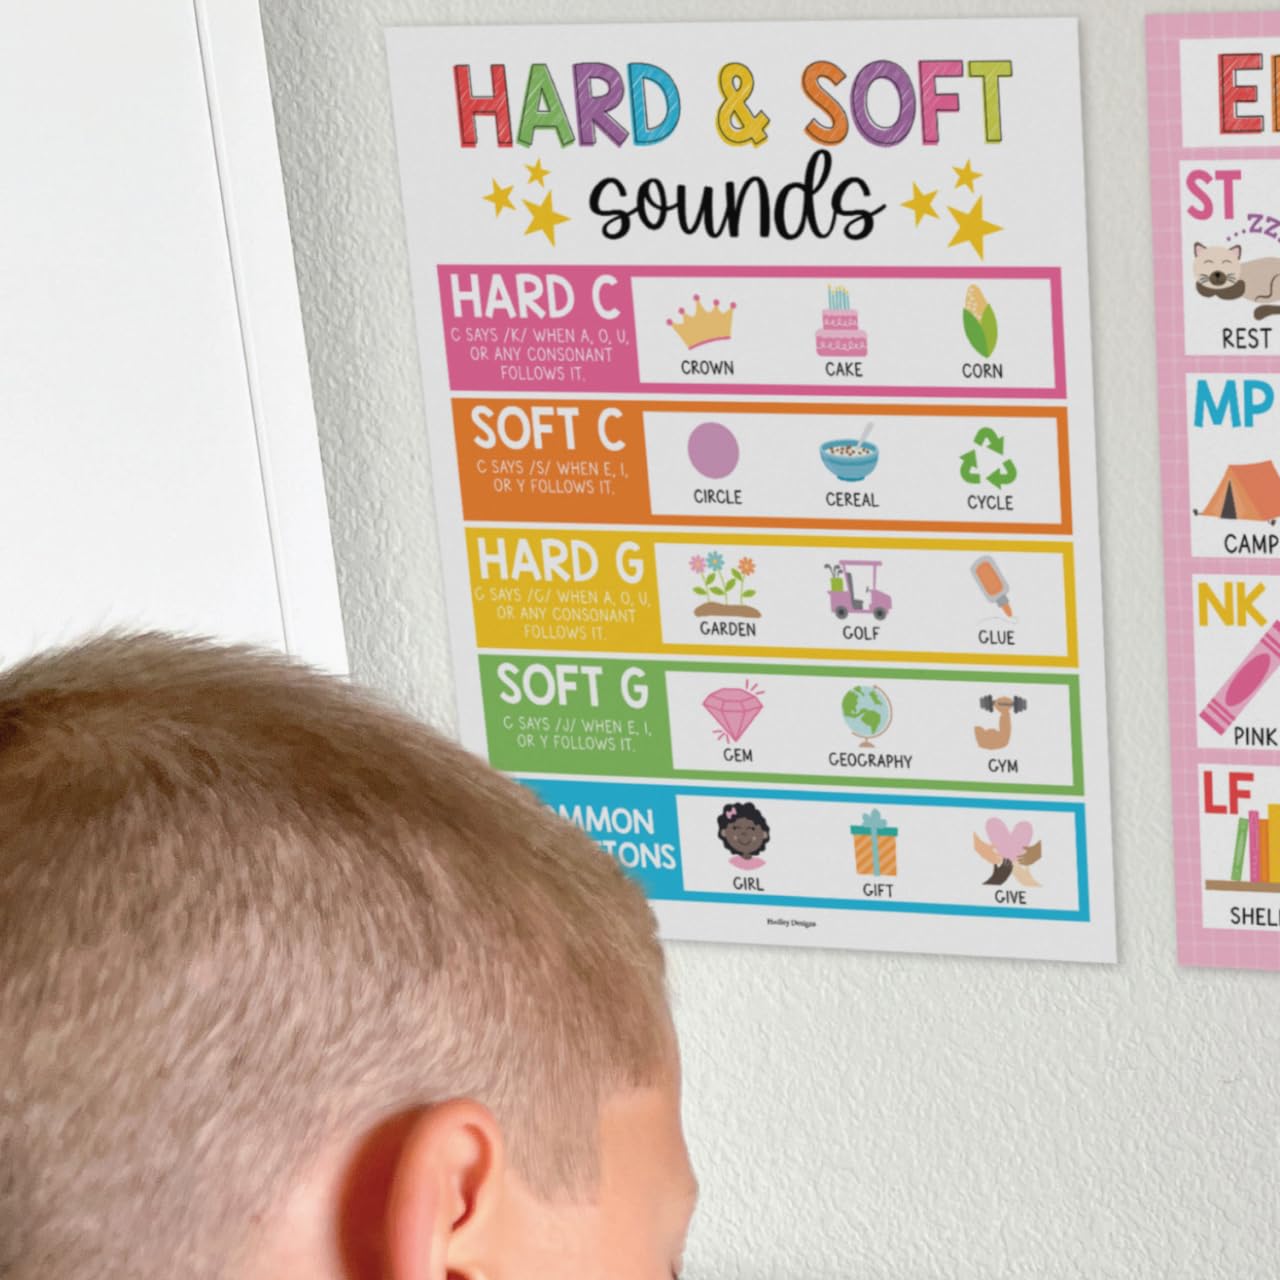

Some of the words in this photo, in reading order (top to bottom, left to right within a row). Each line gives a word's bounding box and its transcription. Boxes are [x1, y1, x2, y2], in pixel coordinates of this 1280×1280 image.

[453, 62, 681, 148] HARD
[715, 62, 770, 148] &
[801, 59, 1012, 147] SOFT
[589, 149, 886, 240] sounds
[1186, 169, 1242, 220] ST
[450, 274, 575, 319] HARD
[592, 275, 621, 320] C
[451, 328, 461, 342] C
[466, 328, 498, 342] SAYS
[504, 328, 526, 343] /K/
[533, 328, 576, 343] WHEN
[1222, 328, 1272, 349] REST
[470, 347, 489, 361] OR
[495, 347, 522, 361] ANY
[527, 347, 612, 363] CONSONANT
[501, 366, 566, 381] FOLLOWS
[681, 360, 734, 376] CROWN
[825, 362, 863, 378] CAKE
[962, 363, 1003, 379] CORN
[1194, 379, 1275, 428] MP
[471, 405, 580, 450] SOFT
[598, 407, 626, 452] C
[693, 489, 743, 505] CIRCLE
[825, 492, 880, 508] CEREAL
[967, 495, 1014, 511] CYCLE
[1224, 534, 1280, 554] CAMP
[477, 537, 600, 583] HARD
[615, 540, 645, 584] G
[1198, 582, 1267, 627] NK
[699, 621, 756, 637] GARDEN
[842, 626, 881, 641] GOLF
[978, 630, 1015, 646] GLUE
[497, 662, 603, 707] SOFT
[620, 667, 649, 709] G
[1234, 727, 1278, 747] PINK
[724, 748, 753, 762] GEM
[828, 752, 912, 769] GEOGRAPHY
[988, 759, 1018, 773] GYM
[1203, 770, 1255, 815] LF
[733, 877, 765, 891] GIRL
[863, 884, 894, 898] GIFT
[994, 890, 1027, 905] GIVE
